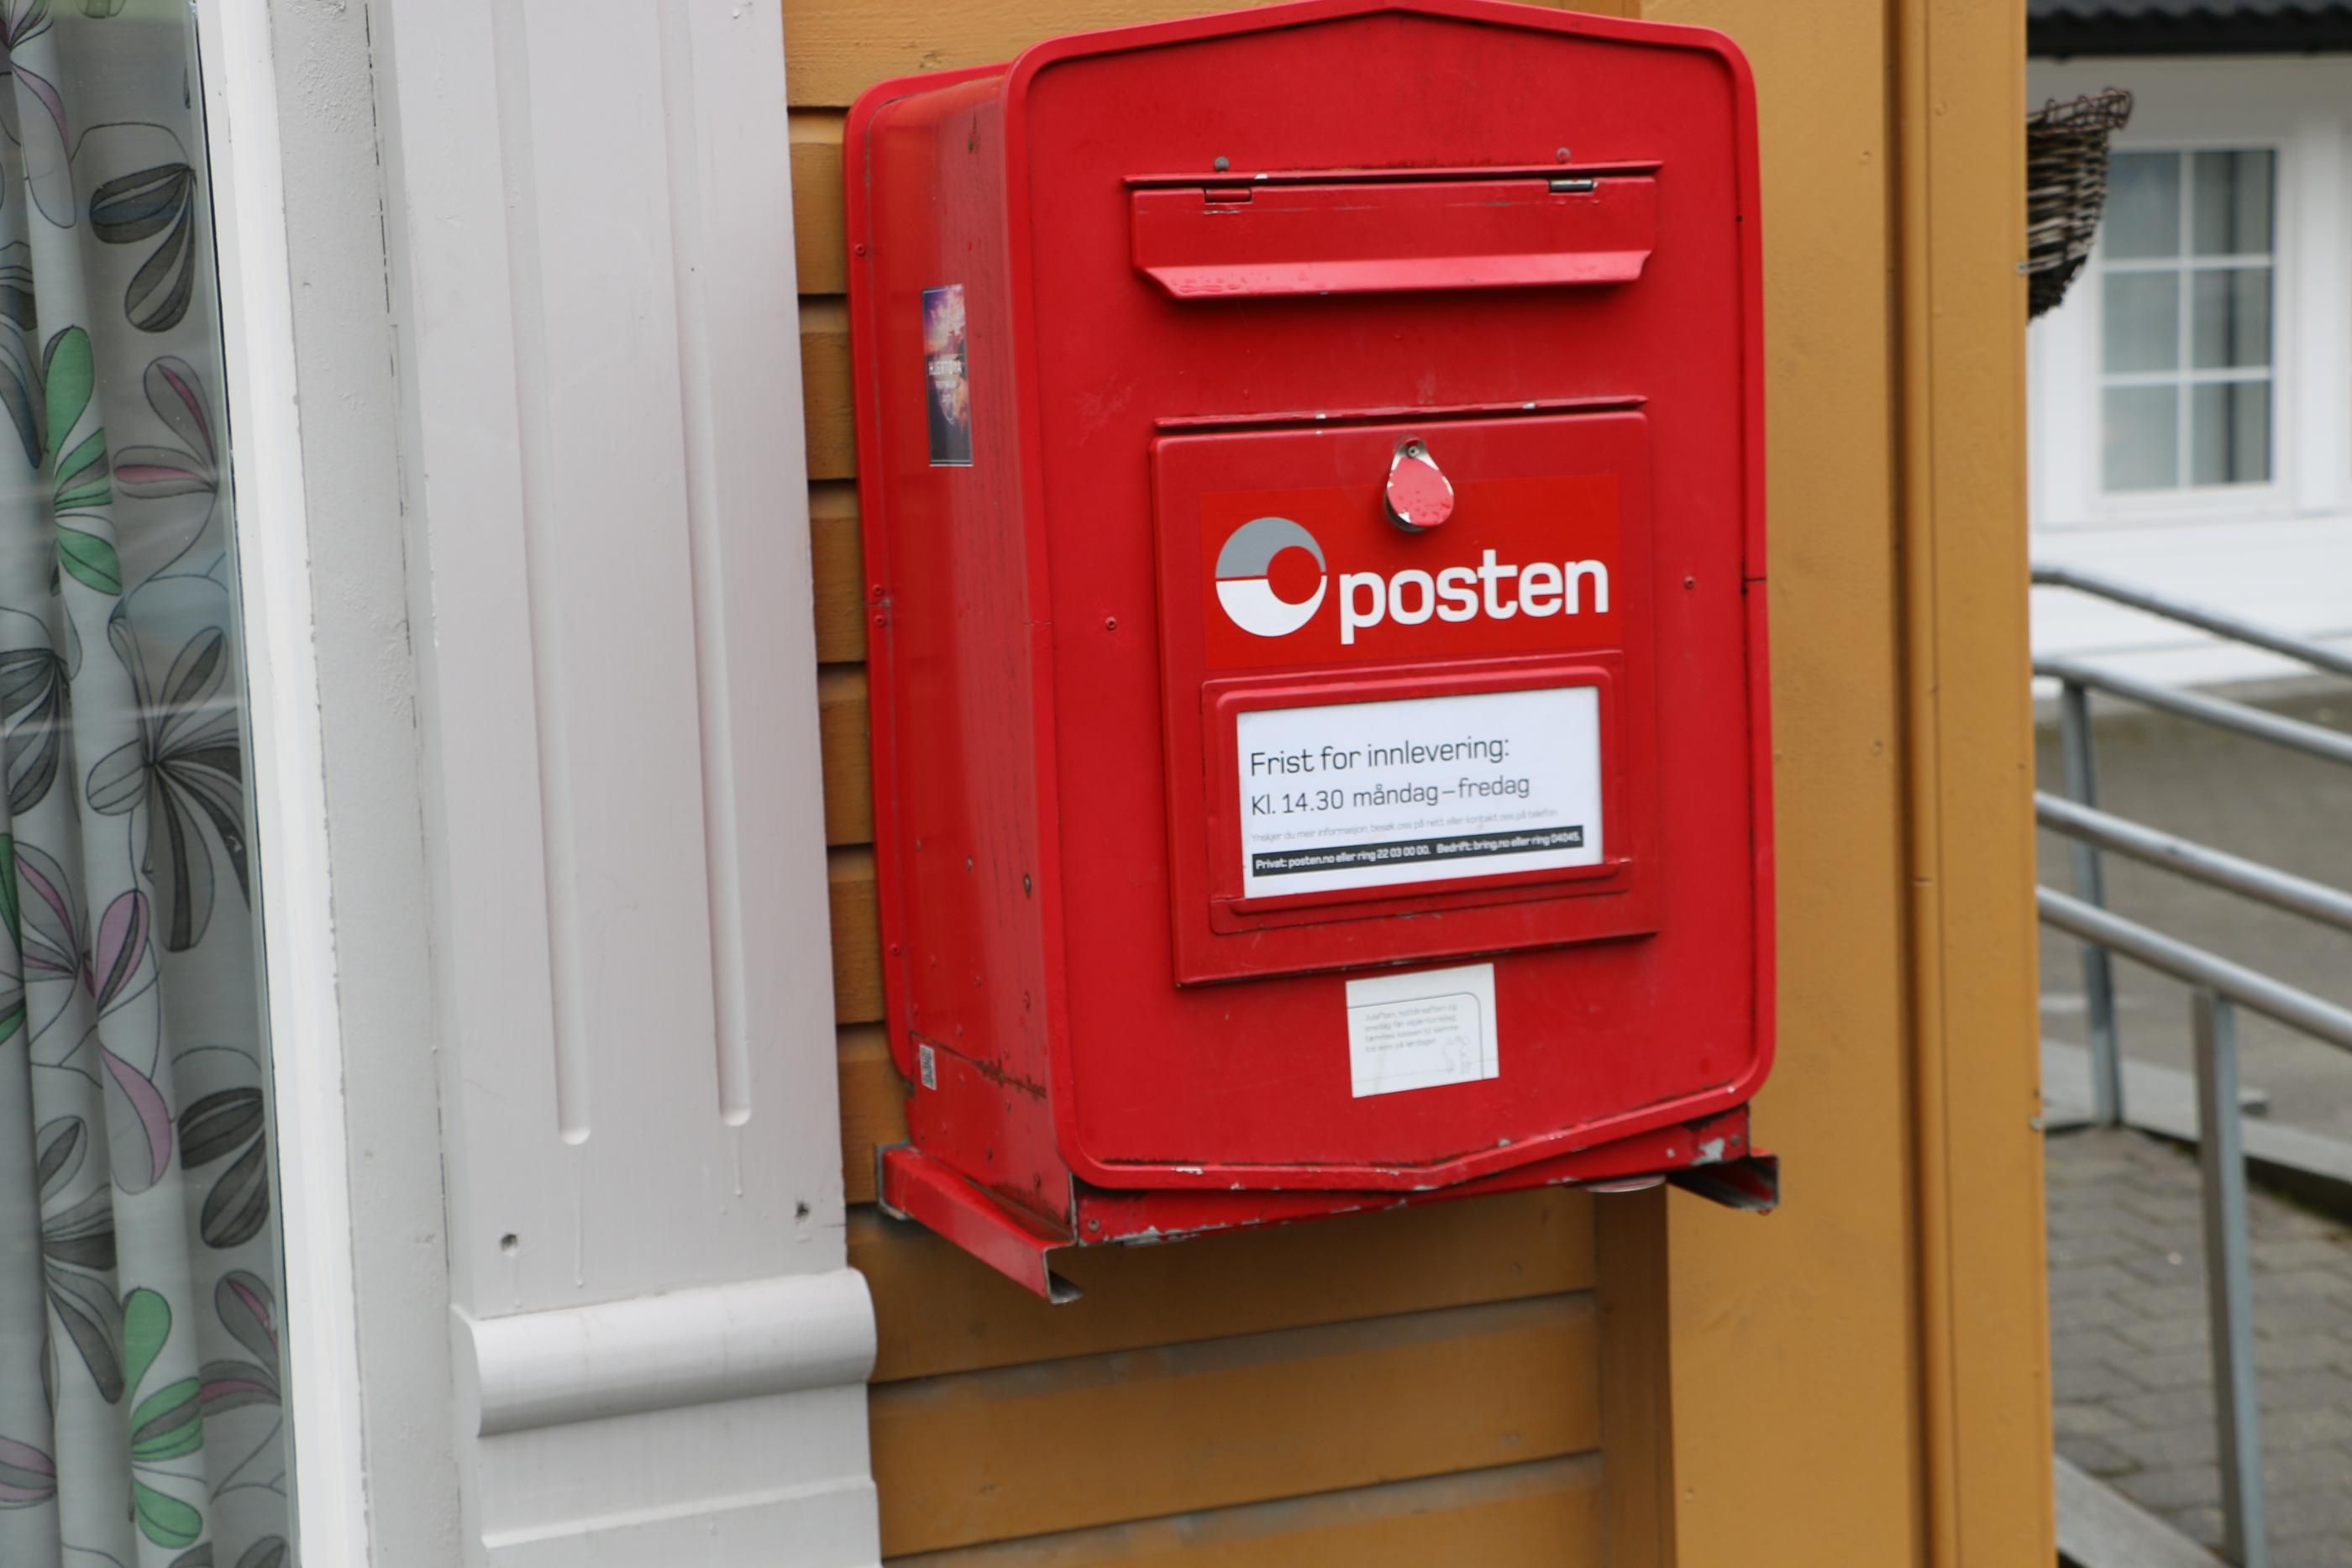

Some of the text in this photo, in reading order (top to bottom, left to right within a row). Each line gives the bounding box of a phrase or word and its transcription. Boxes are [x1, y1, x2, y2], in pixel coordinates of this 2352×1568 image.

[1339, 549, 1609, 645] posten
[1251, 736, 1510, 776] Frist for innlevering:
[1252, 794, 1276, 815] Kl.
[1282, 789, 1344, 814] 14.30
[1255, 858, 1287, 870] Privat:
[1289, 853, 1335, 868] posten.no
[1336, 851, 1357, 863] eller
[1357, 850, 1376, 863] ring
[1377, 848, 1389, 860] 22
[1389, 847, 1401, 858] 03
[1403, 845, 1415, 857] 00
[1416, 844, 1431, 856] 00.
[1436, 841, 1473, 854] Bedrift:
[1473, 838, 1510, 852] bring.no
[1511, 836, 1530, 848] eller
[1531, 834, 1550, 847] ring
[1284, 830, 1295, 840] du
